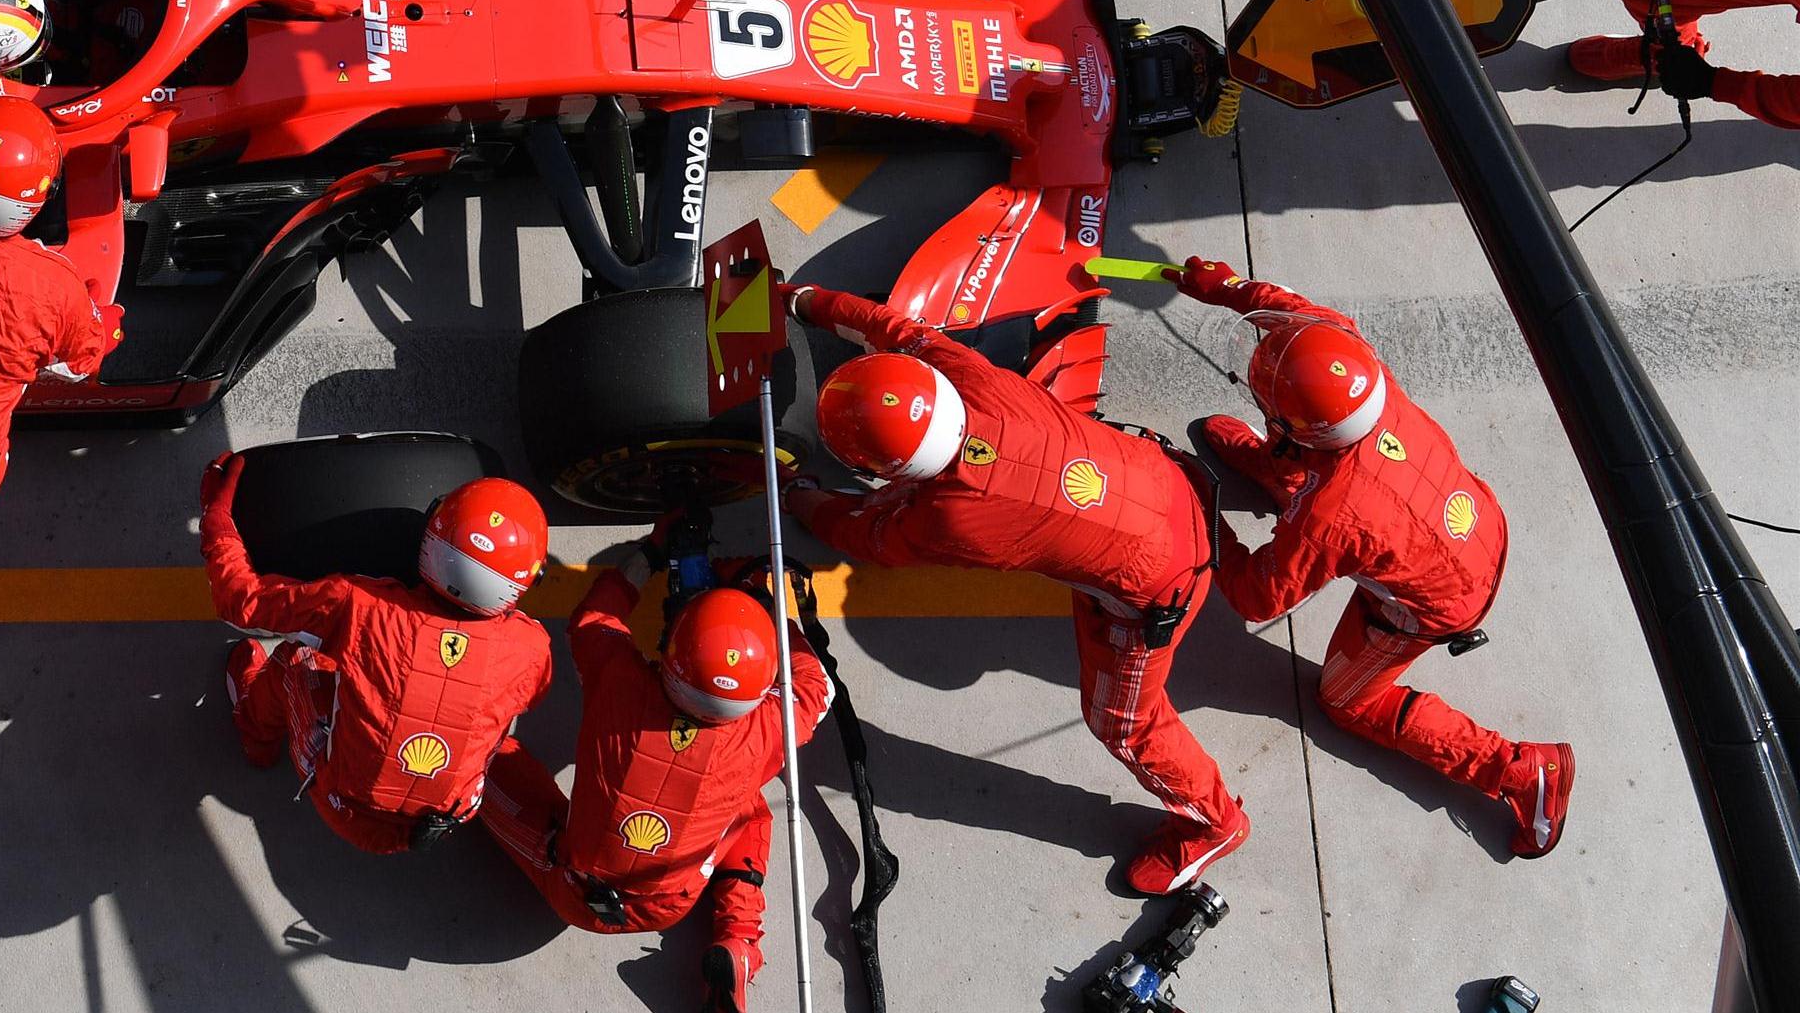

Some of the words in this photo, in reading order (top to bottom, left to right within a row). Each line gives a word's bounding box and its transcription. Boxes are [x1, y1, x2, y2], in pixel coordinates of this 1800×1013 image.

[718, 9, 784, 49] 5
[897, 28, 920, 90] AMD
[926, 20, 946, 96] KASPERSKY
[956, 26, 976, 89] PIRELLI
[982, 18, 1008, 102] MAHLE
[1077, 56, 1091, 93] ACTION
[674, 126, 709, 241] Lenovo
[960, 234, 1001, 303] V-Power
[24, 397, 147, 407] Lenovo
